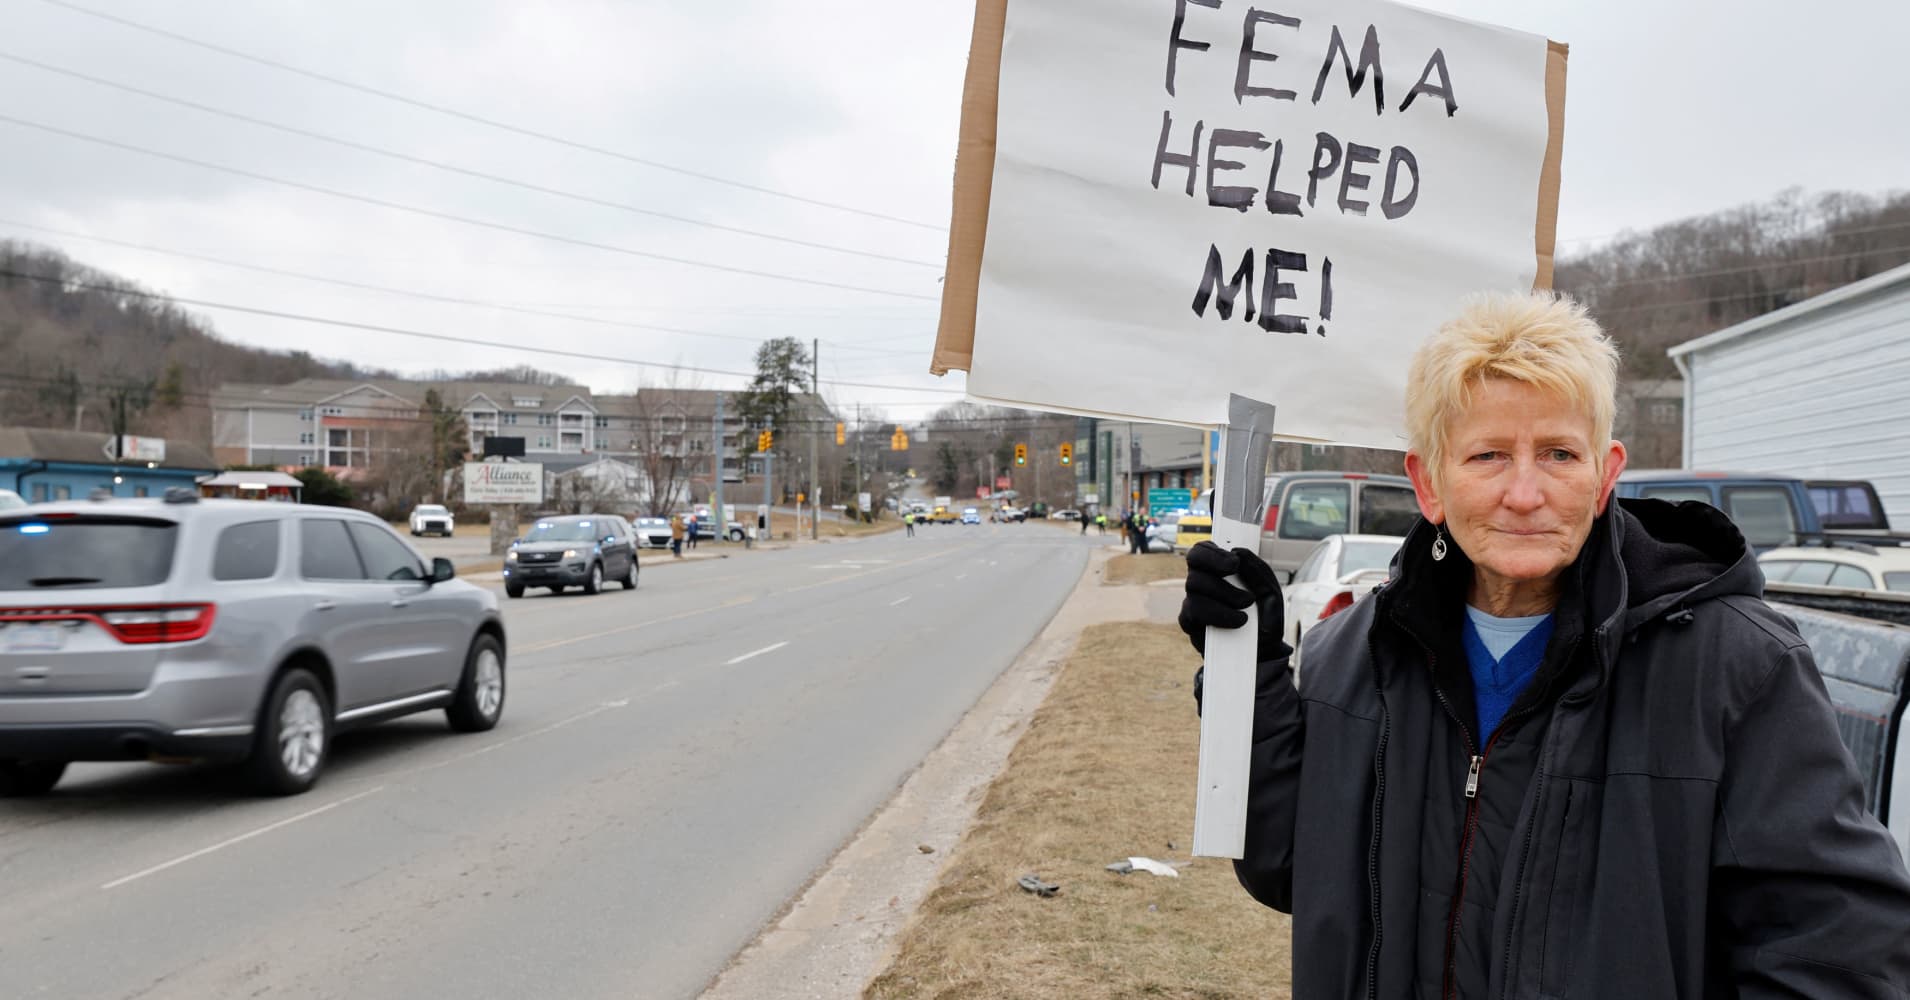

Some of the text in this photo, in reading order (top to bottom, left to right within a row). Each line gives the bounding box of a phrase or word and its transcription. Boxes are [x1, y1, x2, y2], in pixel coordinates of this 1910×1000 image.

[1166, 0, 1458, 116] FEMA
[1151, 110, 1419, 220] HELPED
[1192, 243, 1332, 337] ME!
[471, 465, 532, 485] Alliance
